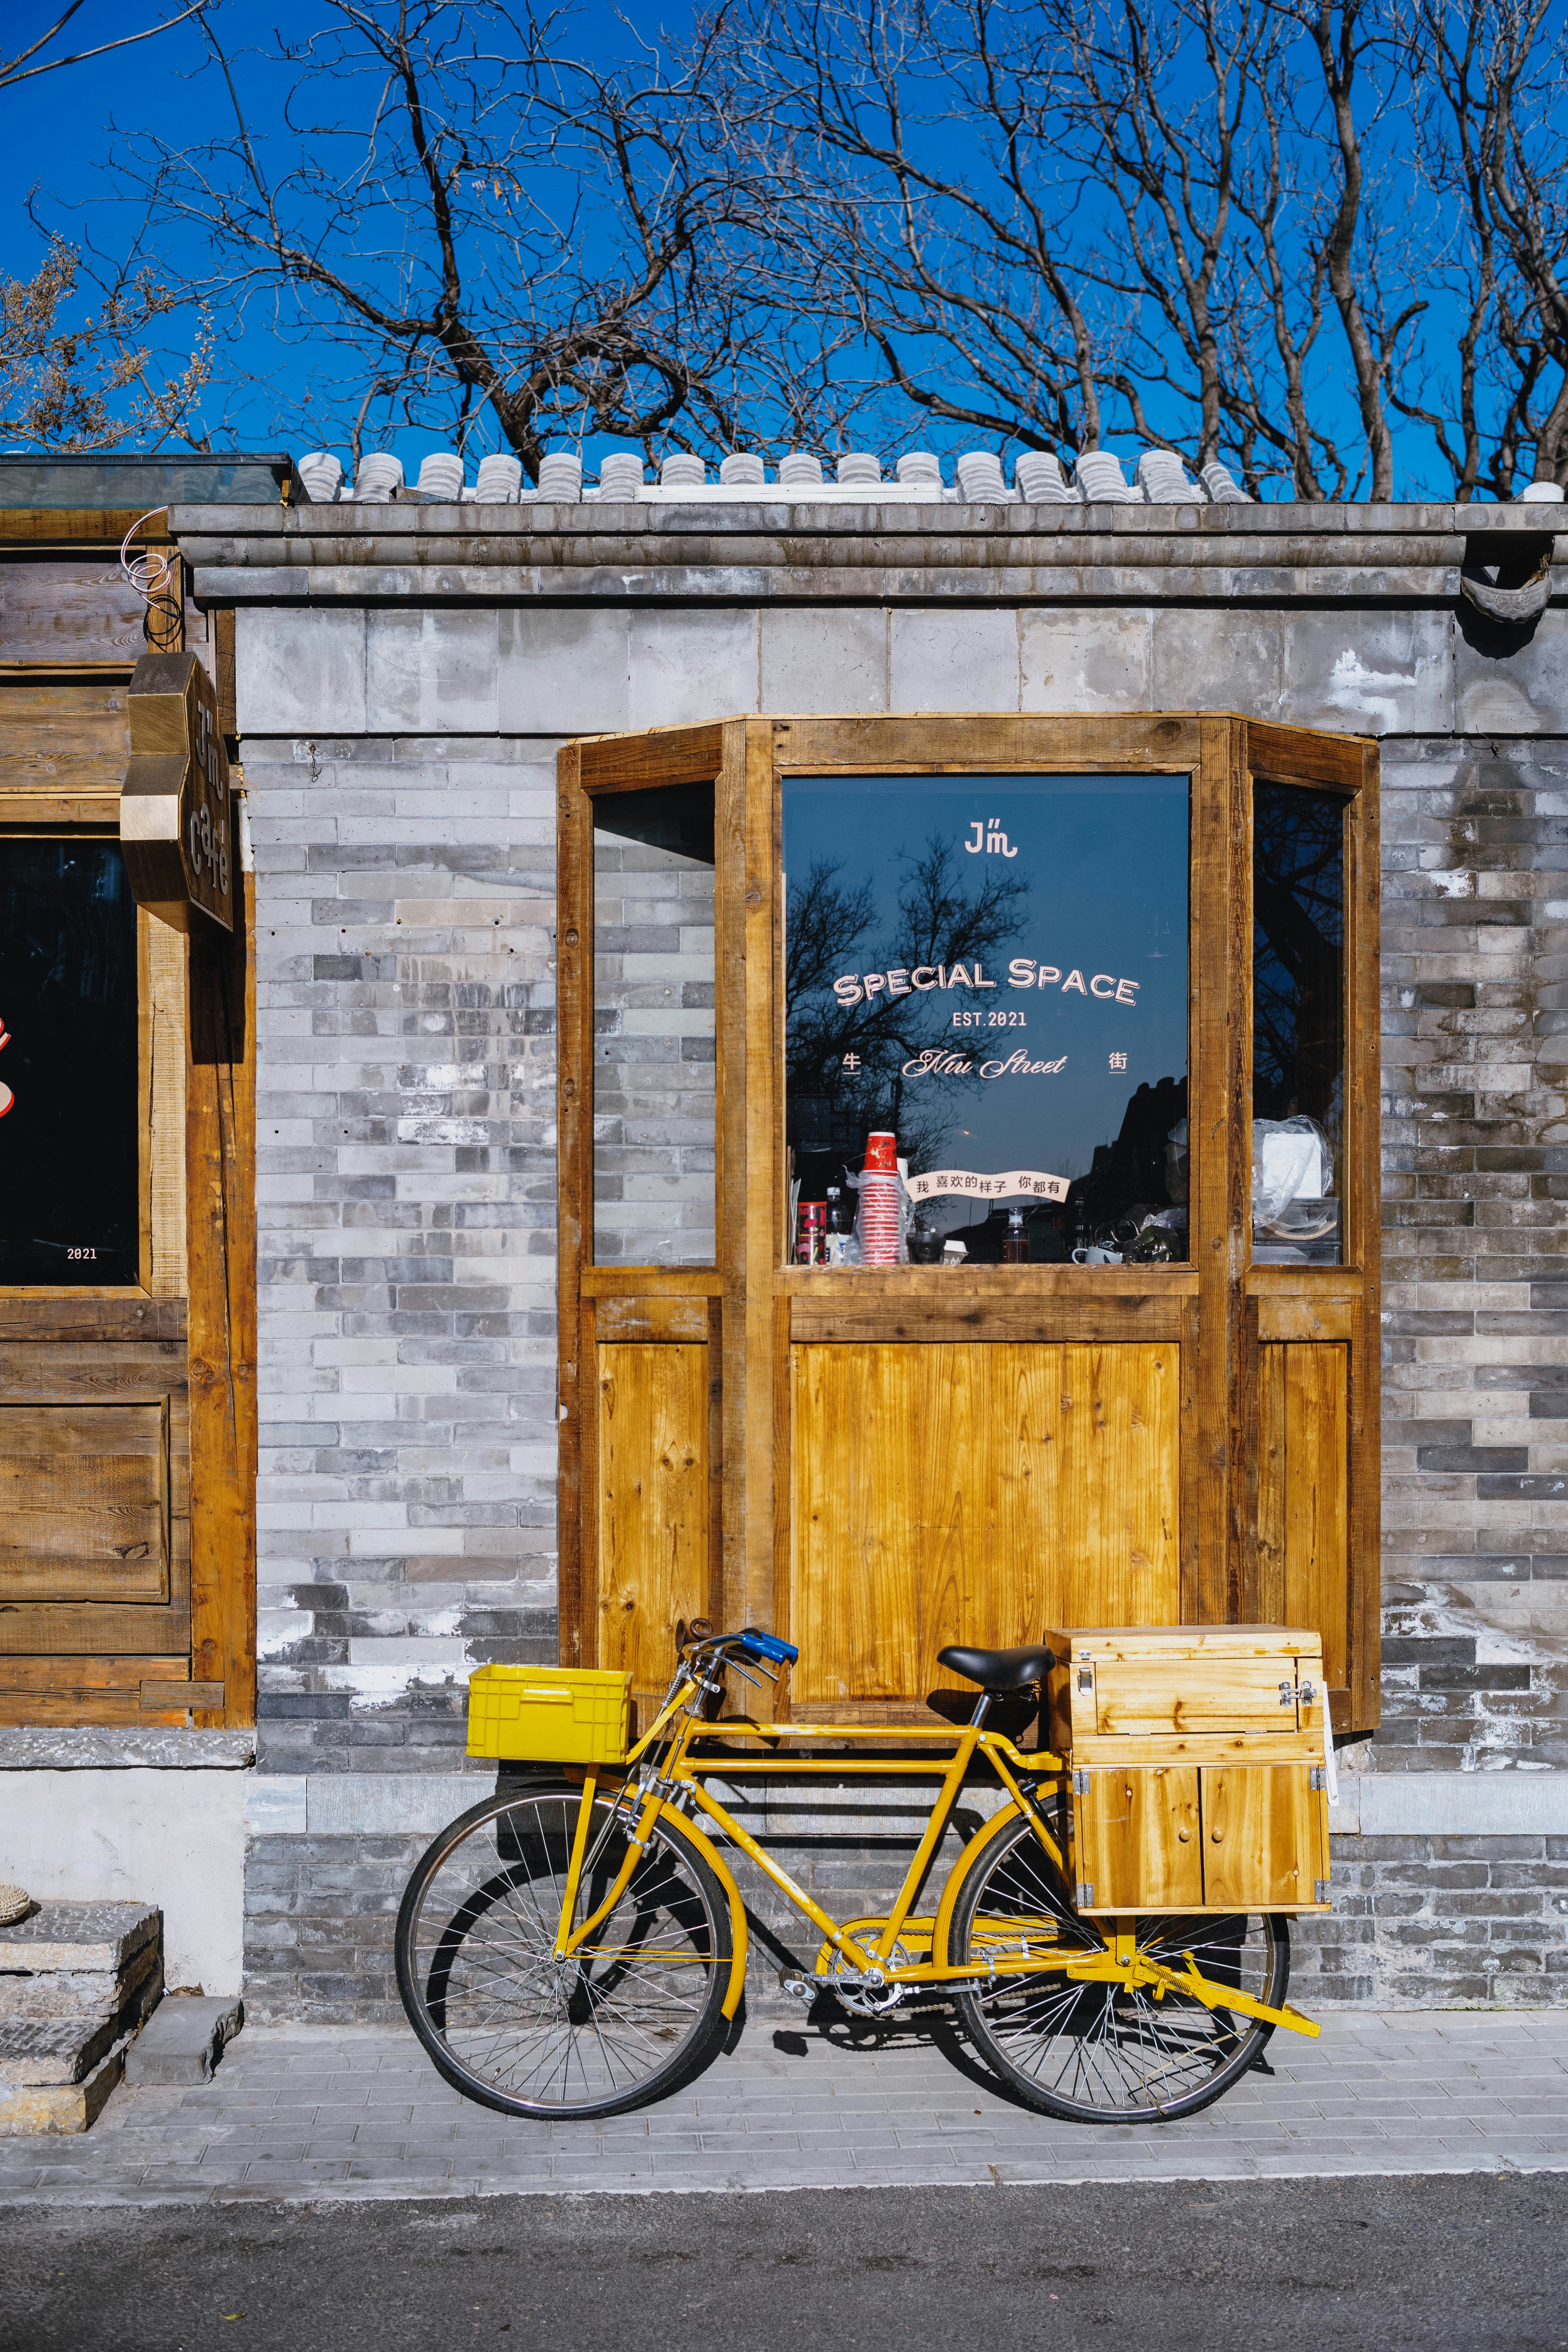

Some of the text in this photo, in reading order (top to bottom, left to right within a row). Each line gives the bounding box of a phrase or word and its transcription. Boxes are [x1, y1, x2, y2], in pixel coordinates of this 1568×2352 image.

[843, 1052, 861, 1070] 牛
[902, 1049, 1068, 1078] Niu Street
[1109, 1052, 1128, 1069] 街
[67, 1248, 97, 1259] 2021
